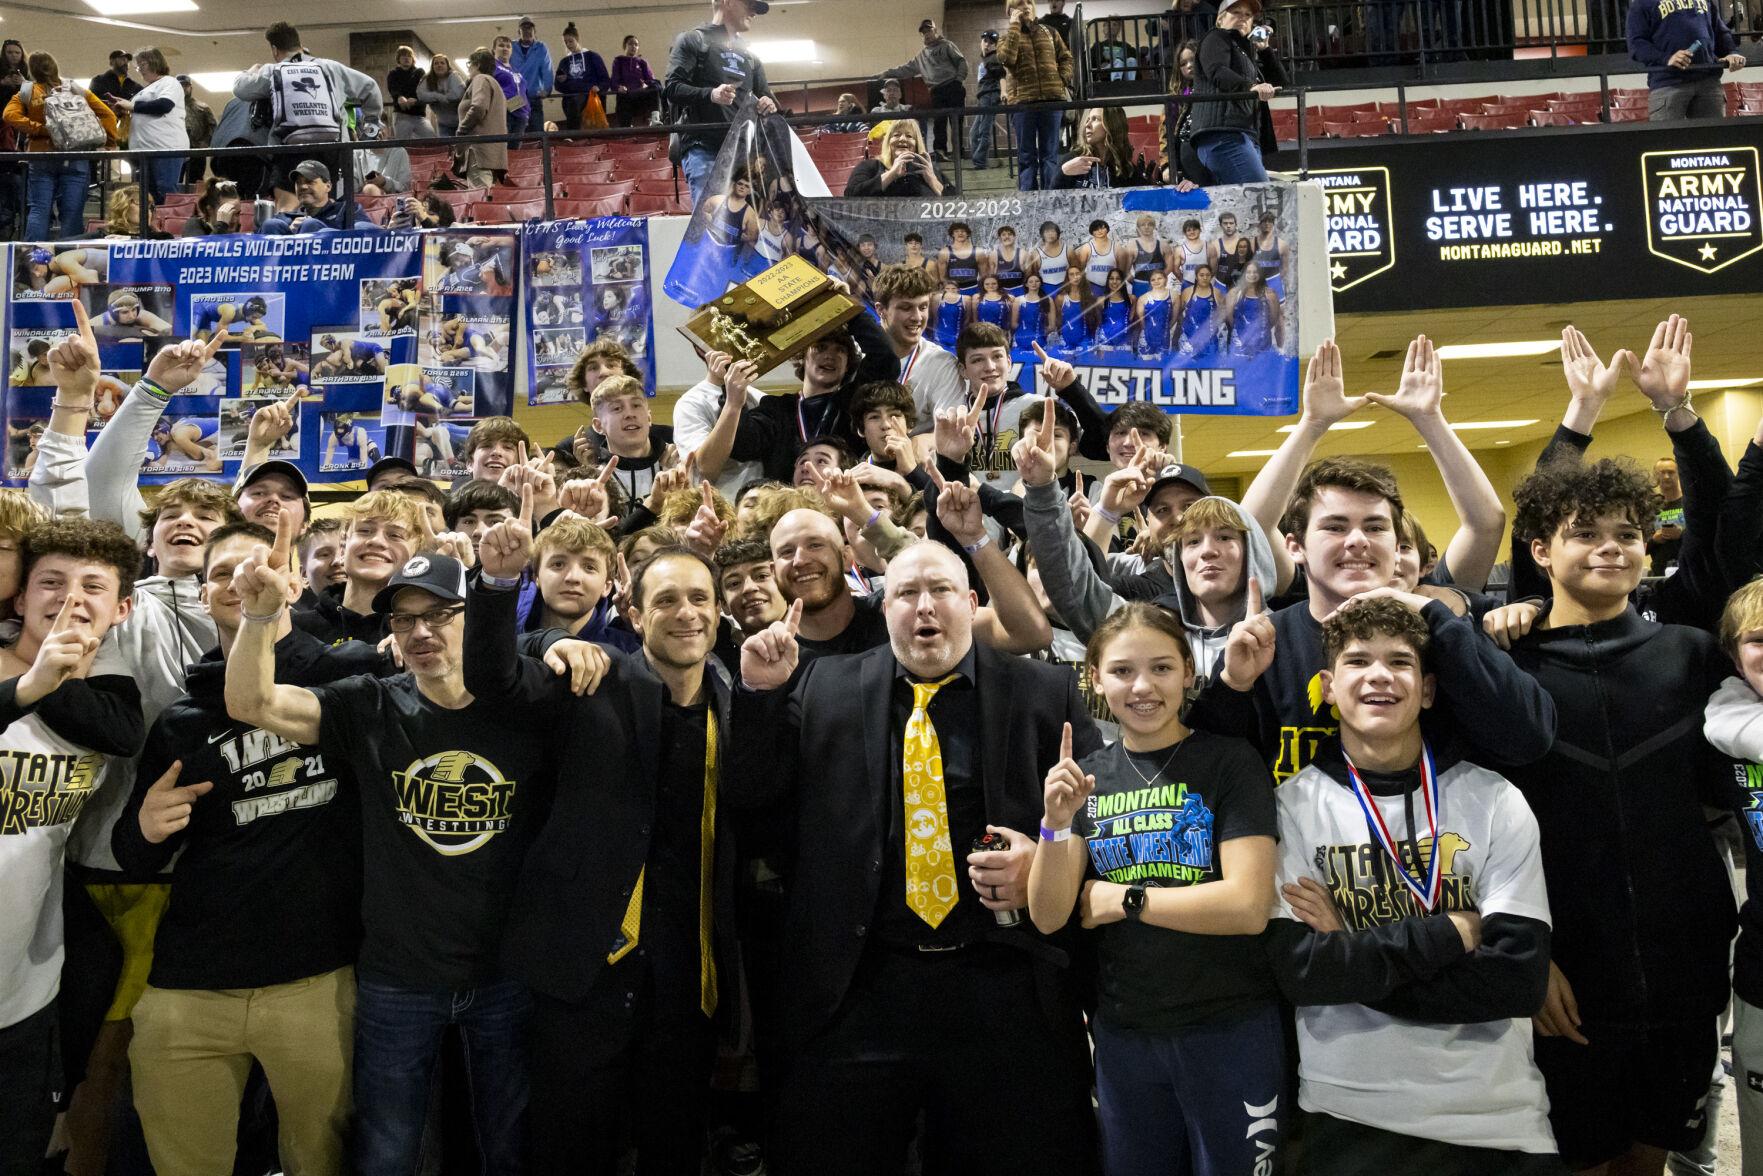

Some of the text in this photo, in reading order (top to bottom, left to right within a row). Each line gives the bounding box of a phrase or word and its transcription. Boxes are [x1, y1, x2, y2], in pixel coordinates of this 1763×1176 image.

[1671, 155, 1730, 168] MONTANA
[1314, 175, 1361, 187] ONTANA
[1658, 173, 1745, 198] ARMY
[1432, 181, 1602, 213] LIVE HERE.
[1658, 196, 1749, 213] NATIONAL
[920, 199, 1022, 219] 2022-2023
[1327, 215, 1379, 231] IONAL
[1426, 209, 1613, 240] SERVE HERE.
[1660, 210, 1751, 235] GUARD
[113, 242, 192, 259] COLUMBIA
[195, 241, 243, 258] FALLS
[332, 236, 372, 254] GOOD
[376, 235, 419, 253] LUCK!
[555, 232, 615, 249] Good Luck!
[1328, 229, 1381, 252] ARD
[1440, 238, 1602, 261] MONTANAGUARD.NET
[179, 263, 354, 284] 2023 MHSA STATE TEAM
[757, 262, 793, 285] 2022-2023
[777, 274, 789, 284] AA
[779, 276, 801, 293] STATE
[775, 275, 820, 304] CHAMPIONS
[242, 754, 325, 792] 20 21
[392, 771, 516, 820] WEST
[1087, 783, 1188, 818] 2023 MONTANA
[399, 812, 505, 832] WRESTLING
[1112, 813, 1174, 836] ALL CLASS
[1089, 836, 1133, 874] STATE
[1108, 862, 1204, 884] TOURNAMENT
